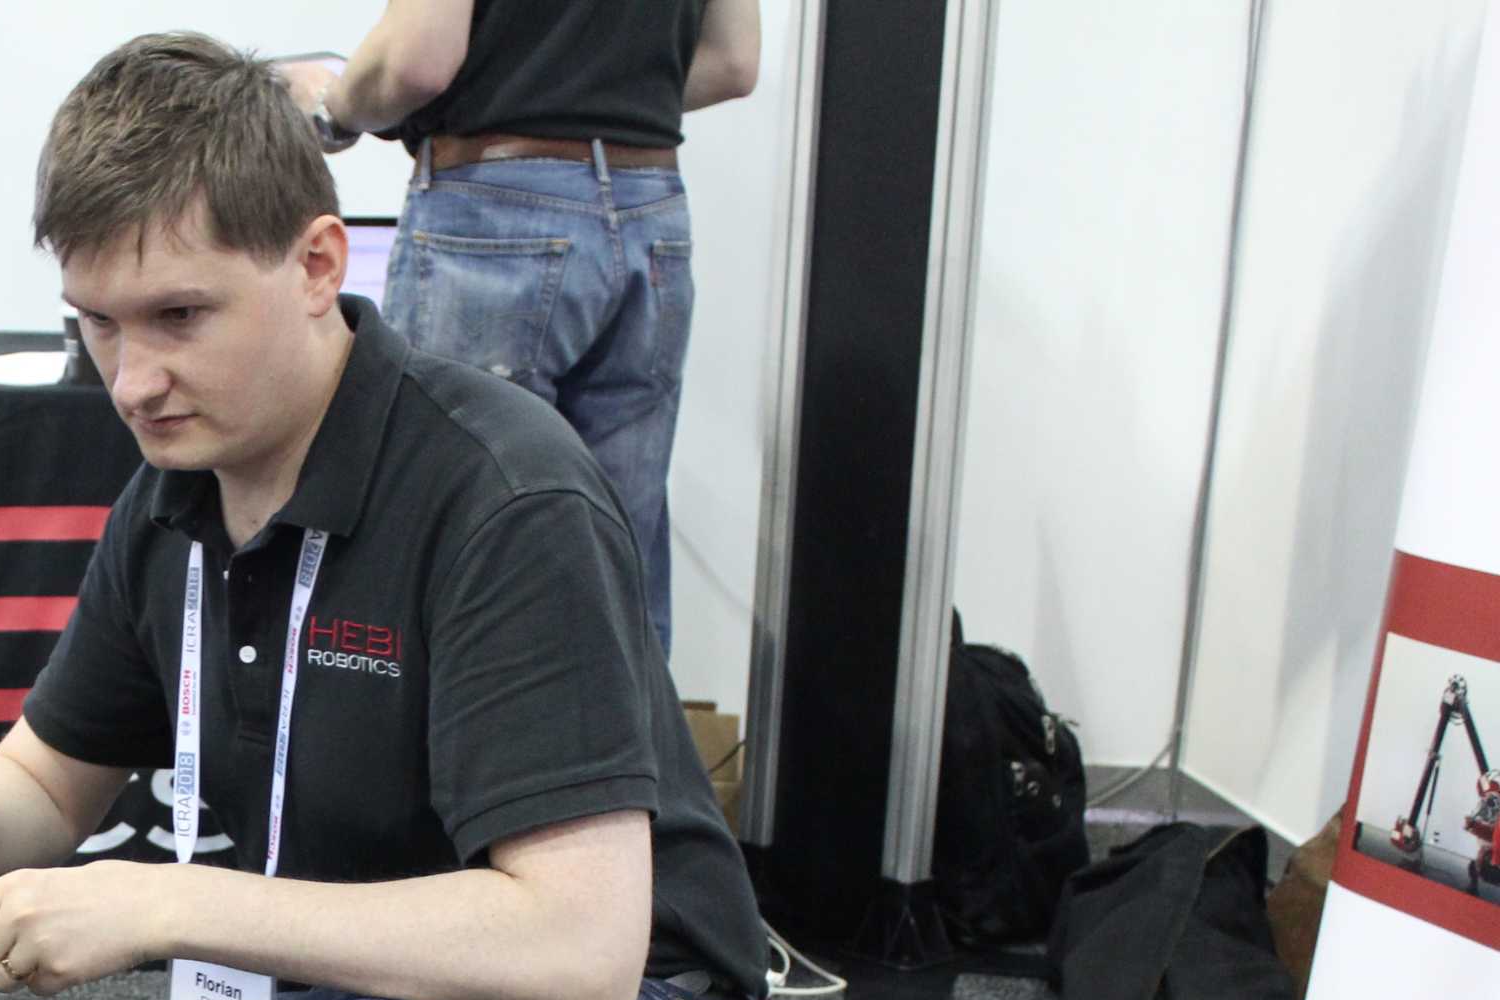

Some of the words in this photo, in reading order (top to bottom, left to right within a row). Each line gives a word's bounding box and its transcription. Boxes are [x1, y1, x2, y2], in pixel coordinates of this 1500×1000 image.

[308, 615, 403, 660] HEBI
[307, 648, 401, 677] ROBOTICS
[181, 669, 192, 715] BOSCH
[176, 751, 196, 837] ICRA2018
[195, 972, 242, 1000] Florian
